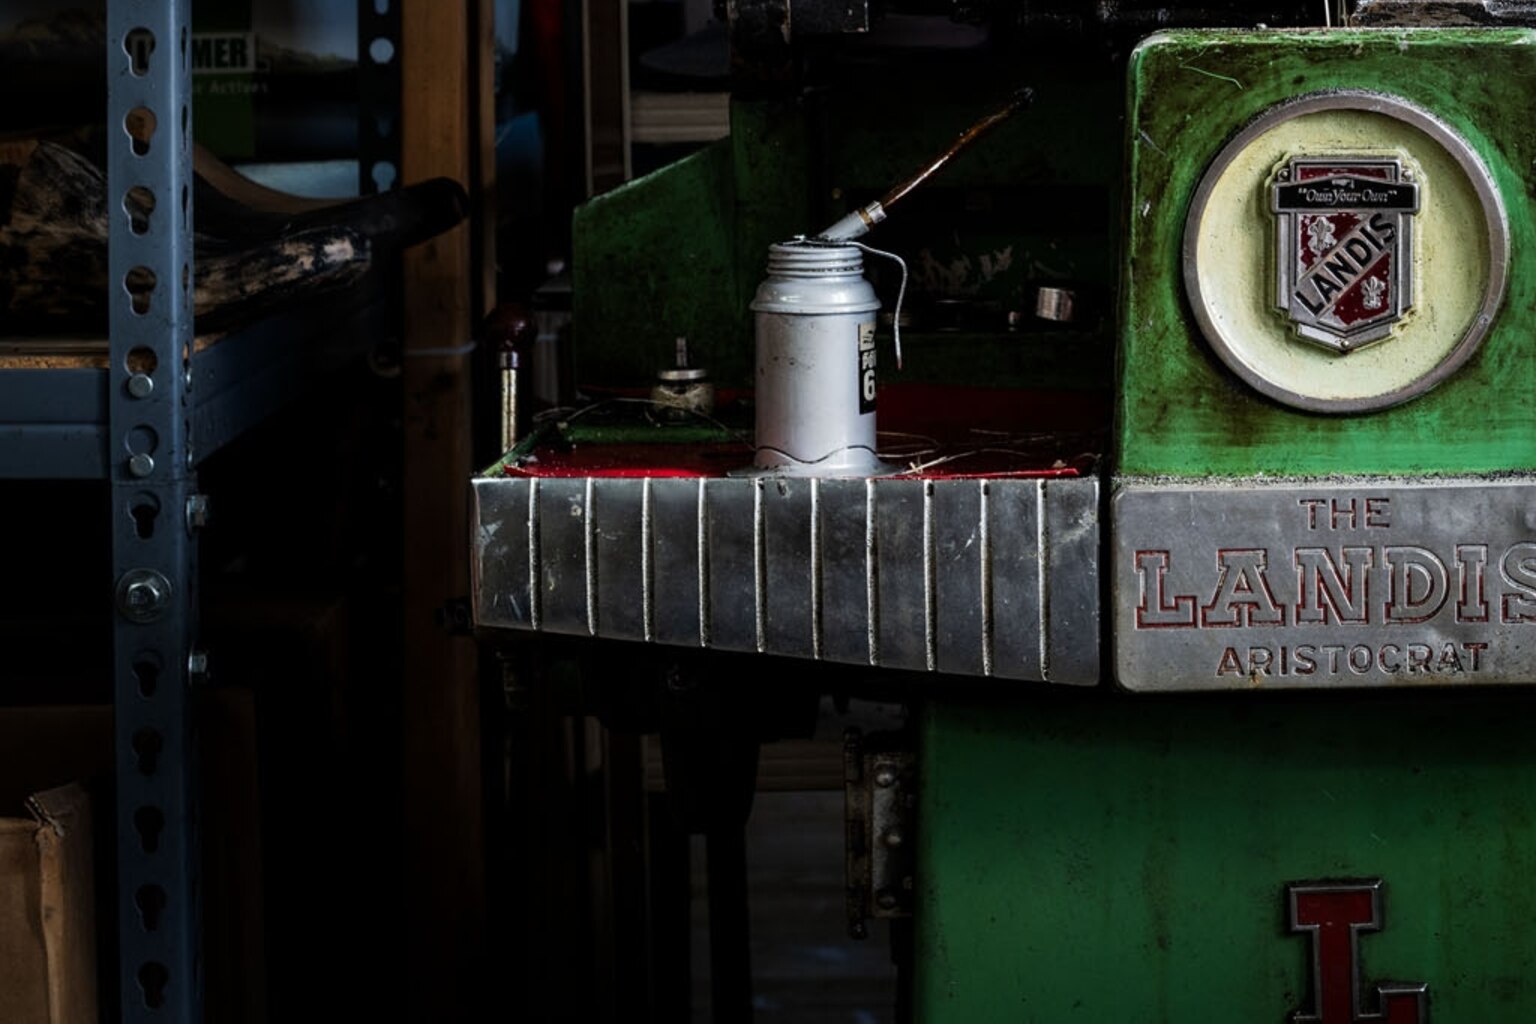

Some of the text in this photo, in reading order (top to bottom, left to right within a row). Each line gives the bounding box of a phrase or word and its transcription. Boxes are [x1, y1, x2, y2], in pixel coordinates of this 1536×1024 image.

[1295, 212, 1396, 315] LANDIS
[1299, 497, 1391, 530] THE
[1216, 642, 1489, 676] ARISTOCRAT
